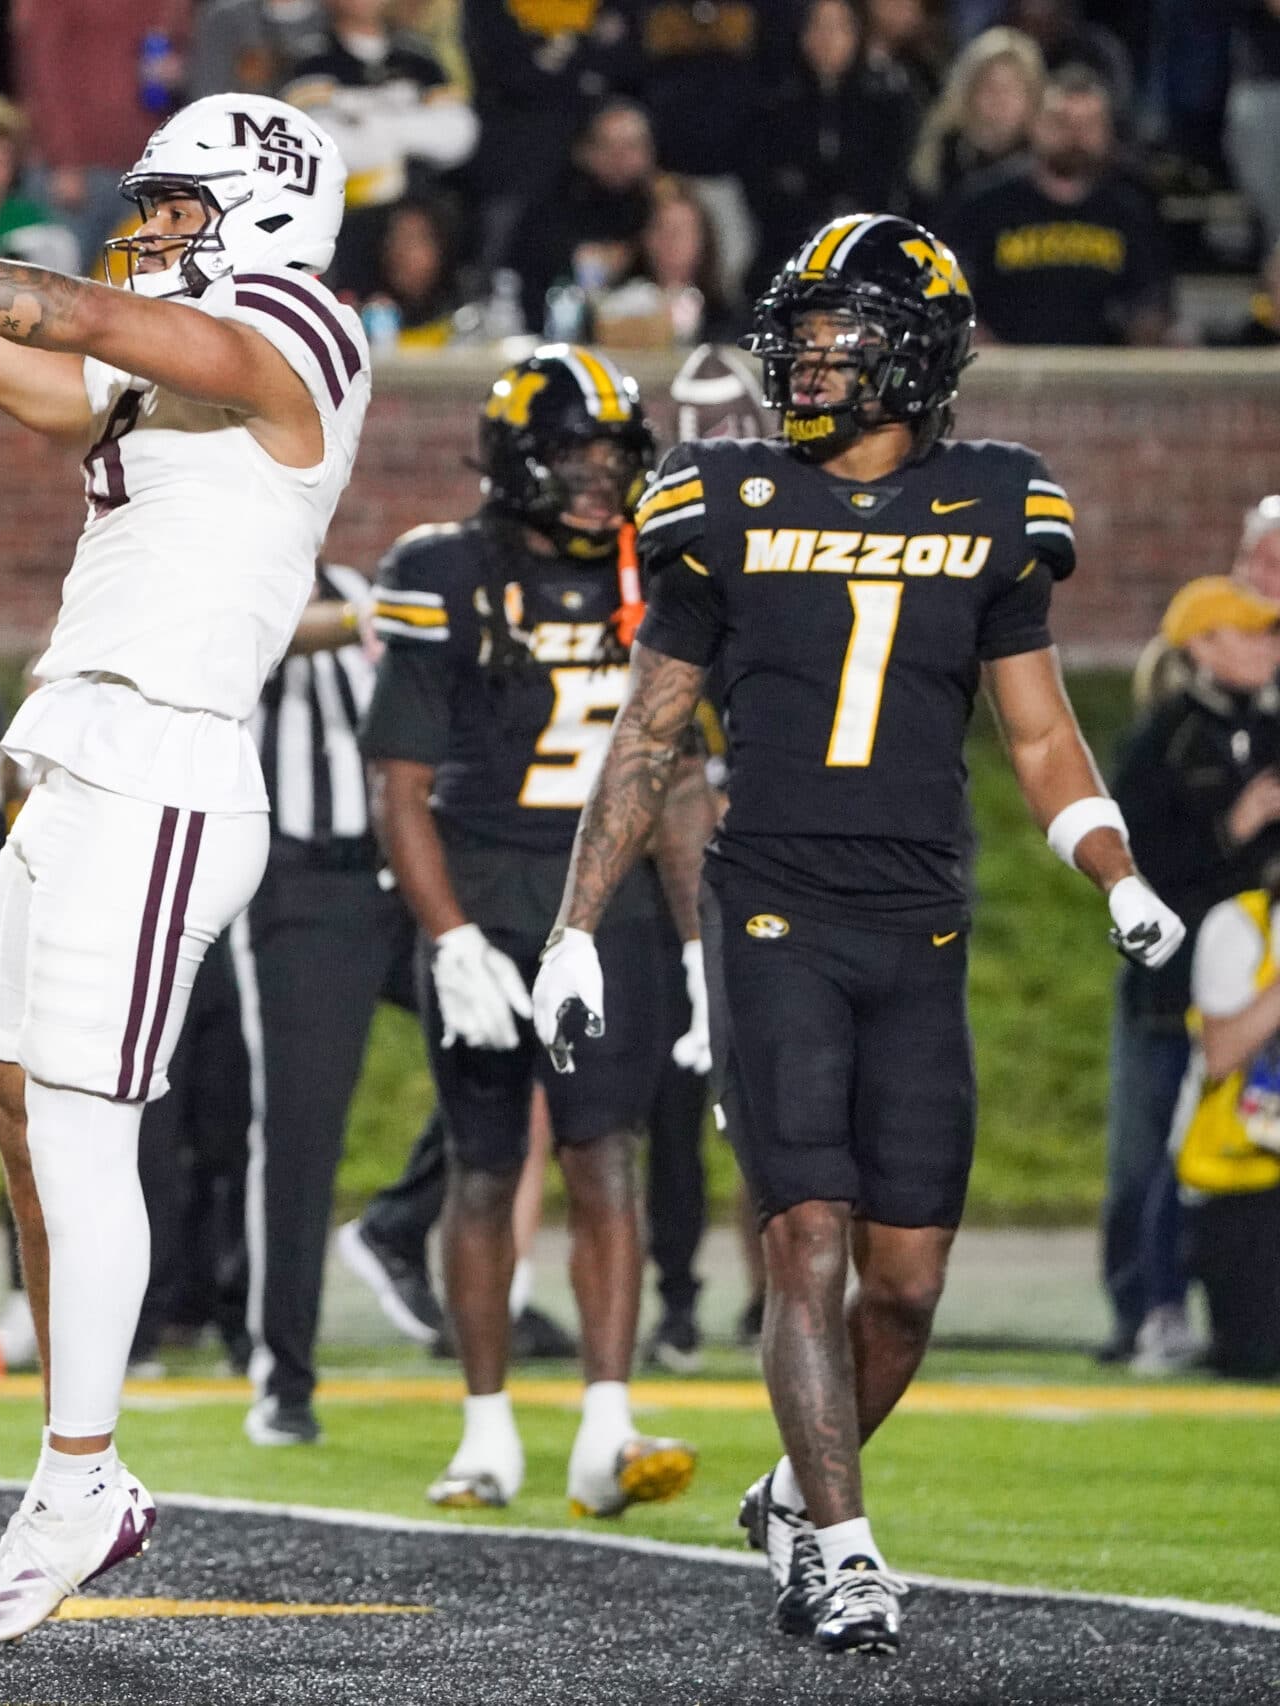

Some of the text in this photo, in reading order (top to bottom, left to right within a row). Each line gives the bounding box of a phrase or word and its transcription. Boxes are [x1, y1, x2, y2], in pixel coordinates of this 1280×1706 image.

[743, 529, 992, 578] MIZZOU
[518, 665, 631, 808] 5
[825, 580, 904, 766] 1
